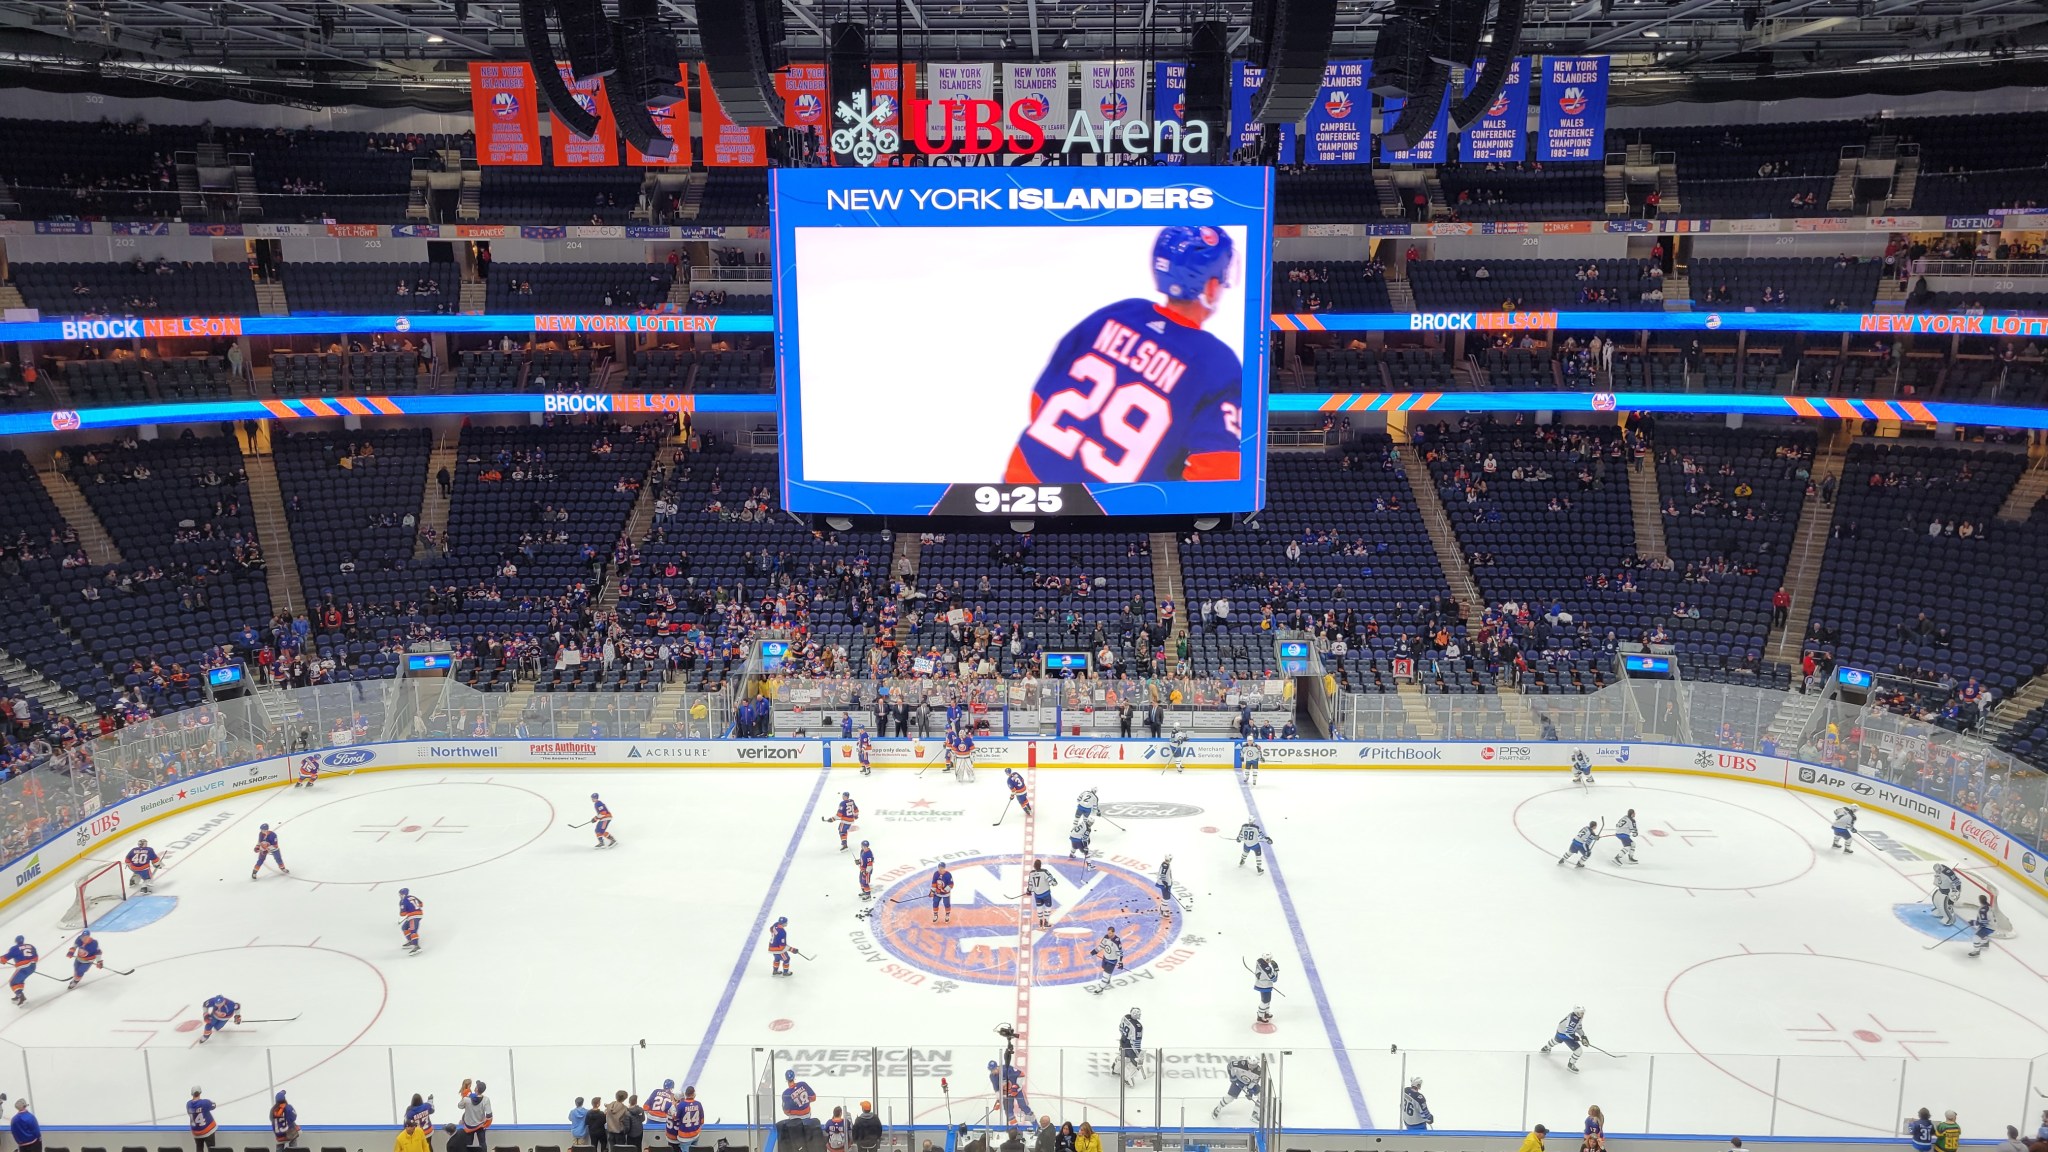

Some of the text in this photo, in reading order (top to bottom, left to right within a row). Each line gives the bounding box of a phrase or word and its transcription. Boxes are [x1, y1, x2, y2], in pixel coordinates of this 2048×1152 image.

[481, 66, 523, 76] NEW YORK
[1325, 65, 1362, 75] EW YORK
[1554, 60, 1598, 71] NEW YORK
[940, 68, 981, 78] NEW YORK
[1015, 67, 1056, 77] NEW YORK
[1093, 67, 1135, 77] NEW YORK
[482, 79, 524, 88] ISLANDERS
[1015, 79, 1056, 88] ISLANDERS
[1093, 79, 1135, 88] ISLANDERS
[1321, 77, 1361, 87] SLANDERS
[1553, 73, 1597, 83] ISLANDERS
[940, 80, 981, 89] ISLANDERS
[908, 98, 1209, 154] UBS Arena
[1320, 122, 1357, 131] CAMPBELL
[1483, 120, 1506, 128] WALES
[1560, 119, 1584, 127] WALES
[1316, 132, 1360, 141] CONFERENCE
[1471, 130, 1516, 139] CONFERENCE
[1548, 128, 1594, 137] CONFERENCE
[1317, 142, 1358, 151] CHAMPIONS
[1473, 140, 1513, 148] CHAMPIONS
[1550, 139, 1591, 147] CHAMPIONS
[827, 187, 1214, 211] NEW YORK ISLANDERS
[1952, 218, 1994, 229] DEFEND
[115, 239, 135, 247] 202
[1523, 238, 1538, 246] 208
[1776, 237, 1794, 245] 209
[1995, 281, 2013, 289] 210
[535, 315, 718, 332] NEW YORK LOTTERY
[1410, 313, 1558, 330] BROCK NELSON
[1860, 315, 1912, 332] NEW
[1917, 315, 1981, 333] YORK
[62, 317, 242, 340] BROCK NELSON
[1092, 319, 1186, 394] NELSON
[545, 394, 695, 412] BROCK NELSON
[1026, 353, 1172, 483] 29
[1220, 402, 1241, 437] 2
[974, 487, 1064, 513] 9:25
[431, 746, 498, 757] Northwell
[530, 742, 597, 753] Parts Authority
[646, 748, 708, 757] ACRISURE
[737, 746, 798, 759] verizon
[1064, 744, 1112, 760] Coca-Cola
[1263, 748, 1337, 758] STOP&SHOP
[1372, 747, 1441, 759] PitchBook
[1596, 747, 1619, 755] Jake's
[333, 750, 363, 765] Ford
[1718, 754, 1757, 772] UBS
[140, 780, 225, 813] Heineken SILVER
[1879, 789, 1940, 820] HYUNDAI
[873, 808, 965, 817] Heineken
[1105, 804, 1180, 817] Ford
[91, 811, 121, 837] UBS
[166, 812, 235, 849] DELMAR
[1961, 820, 2001, 851] Coca-Cola
[131, 854, 148, 865] 40
[1110, 854, 1152, 871] UBS
[876, 849, 981, 883] UBS Arena
[16, 864, 41, 887] DIME
[1033, 876, 1041, 887] 17
[906, 924, 1141, 974] ISLANDES
[774, 1049, 952, 1062] AMERICAN
[794, 1064, 953, 1077] EXPRESS
[190, 1113, 206, 1127] 14
[683, 1111, 700, 1127] 44
[1919, 1129, 1930, 1140] 31
